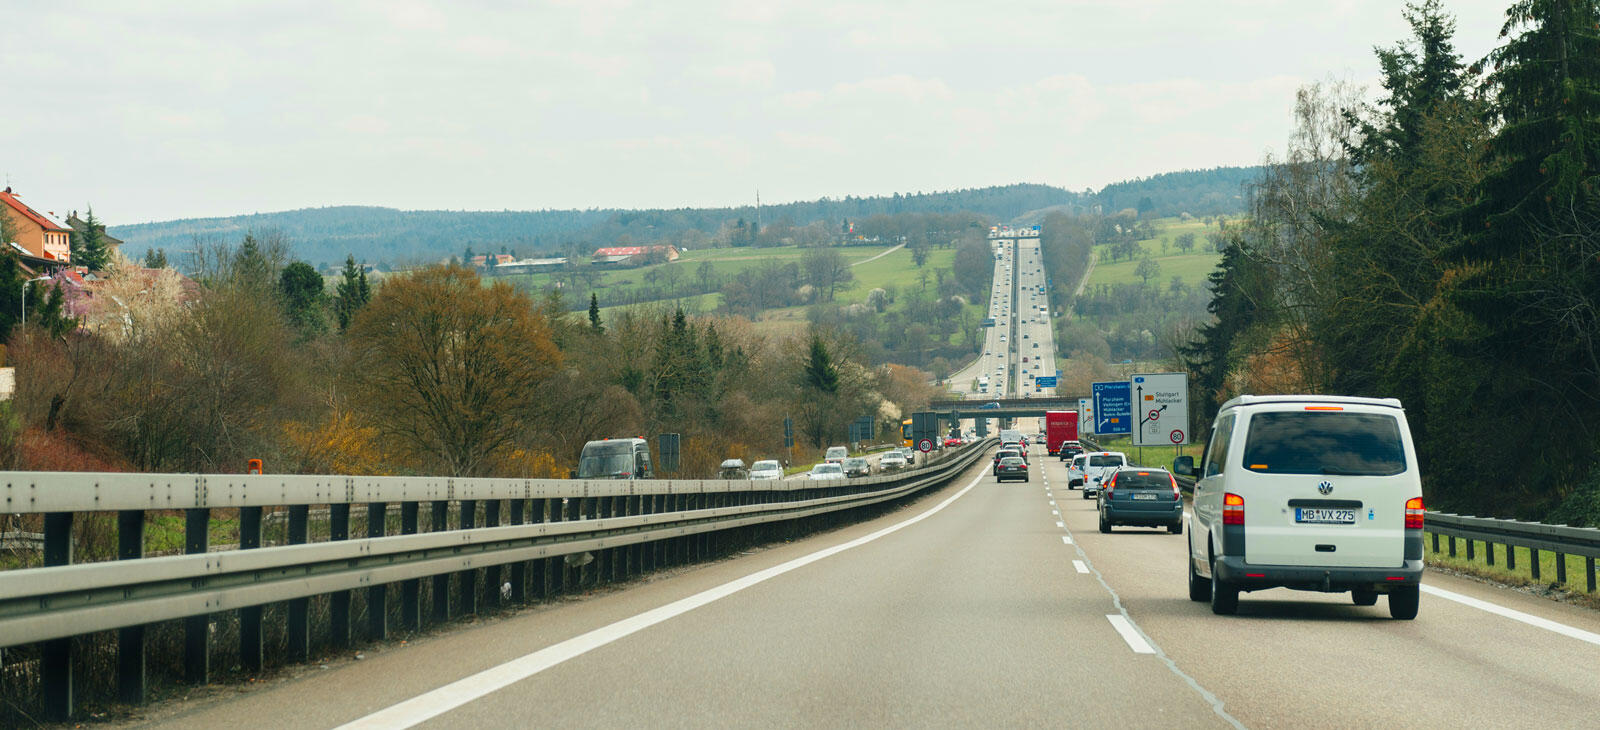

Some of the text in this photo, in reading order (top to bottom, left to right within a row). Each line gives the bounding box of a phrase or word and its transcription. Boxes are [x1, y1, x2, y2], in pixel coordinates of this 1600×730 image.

[1302, 510, 1354, 520] MB VX 275
